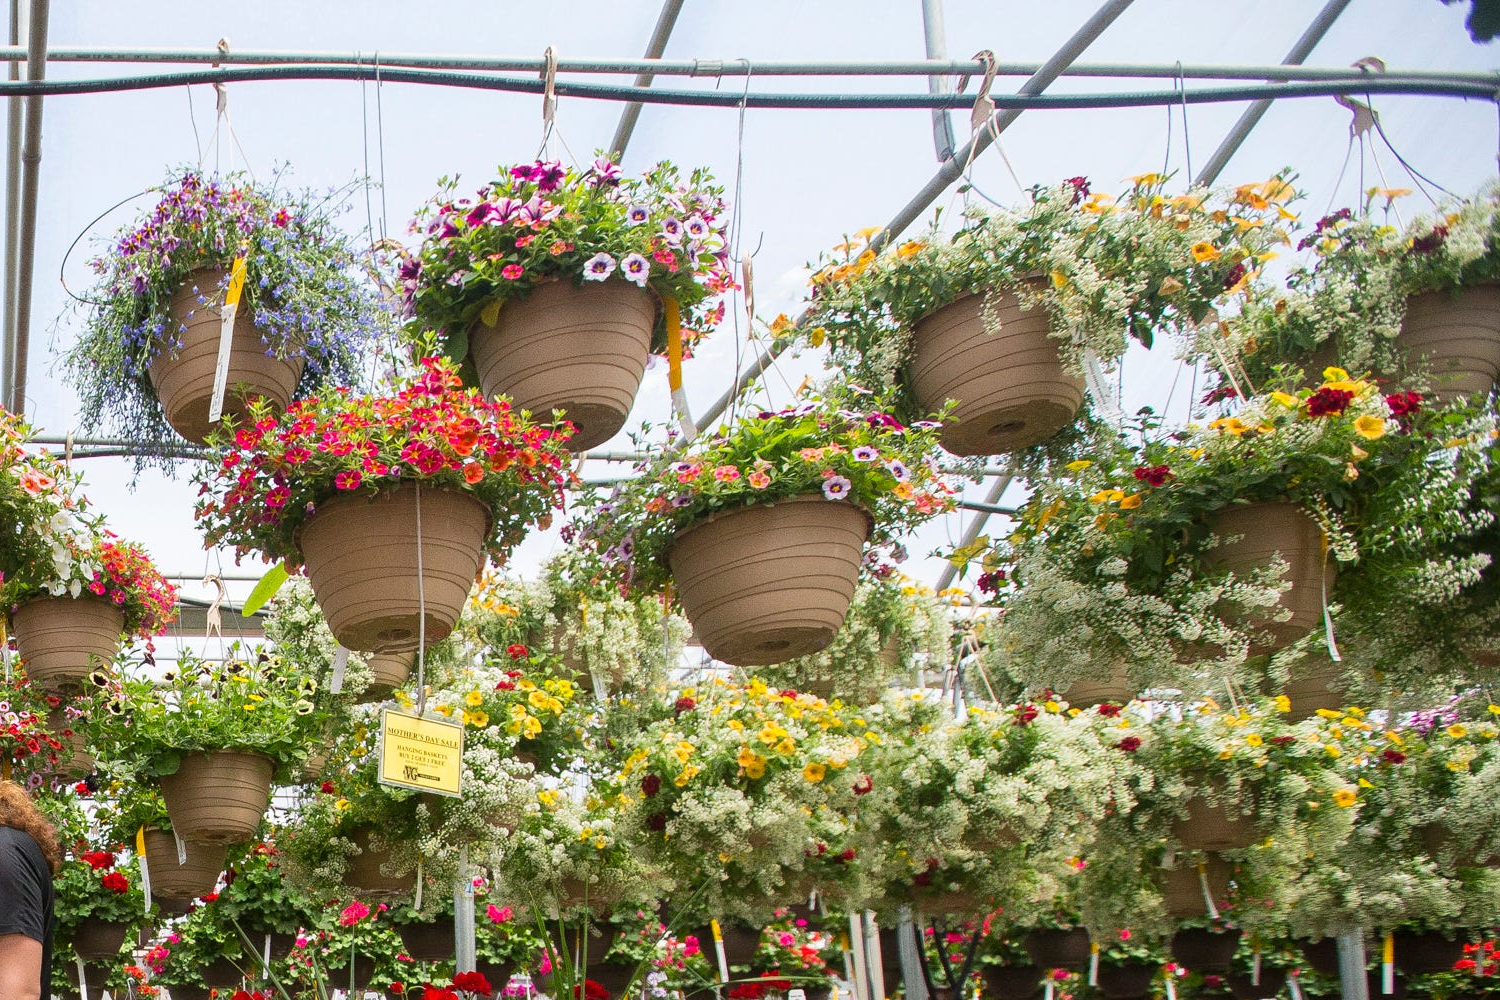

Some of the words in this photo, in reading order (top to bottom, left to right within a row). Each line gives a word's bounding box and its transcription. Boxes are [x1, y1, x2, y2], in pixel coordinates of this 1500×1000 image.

[387, 727, 424, 740] MOTHER'S
[425, 736, 440, 744] DAY
[441, 738, 458, 748] SALE
[397, 745, 423, 756] HANGING
[423, 750, 448, 760] BASKETS
[399, 752, 410, 760] BUY
[431, 758, 445, 766] FREE
